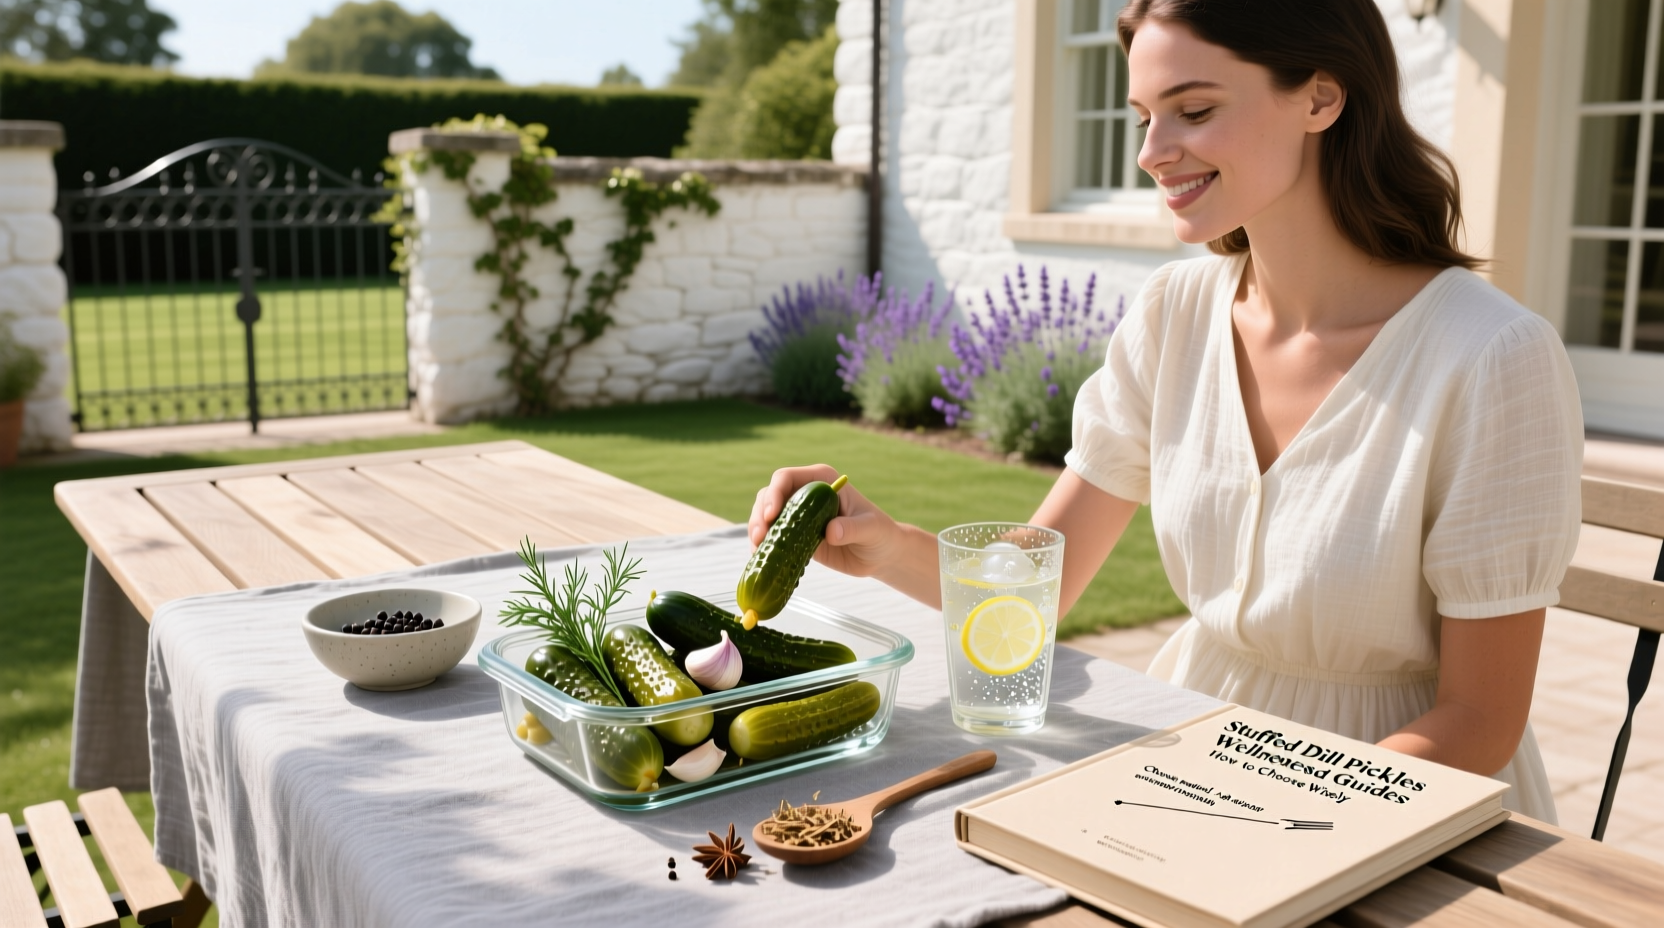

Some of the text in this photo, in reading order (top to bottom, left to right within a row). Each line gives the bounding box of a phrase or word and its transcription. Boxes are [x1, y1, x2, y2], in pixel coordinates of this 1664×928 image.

[1224, 721, 1427, 792] Stuffed Dill Pickles
[1333, 773, 1410, 804] Guides
